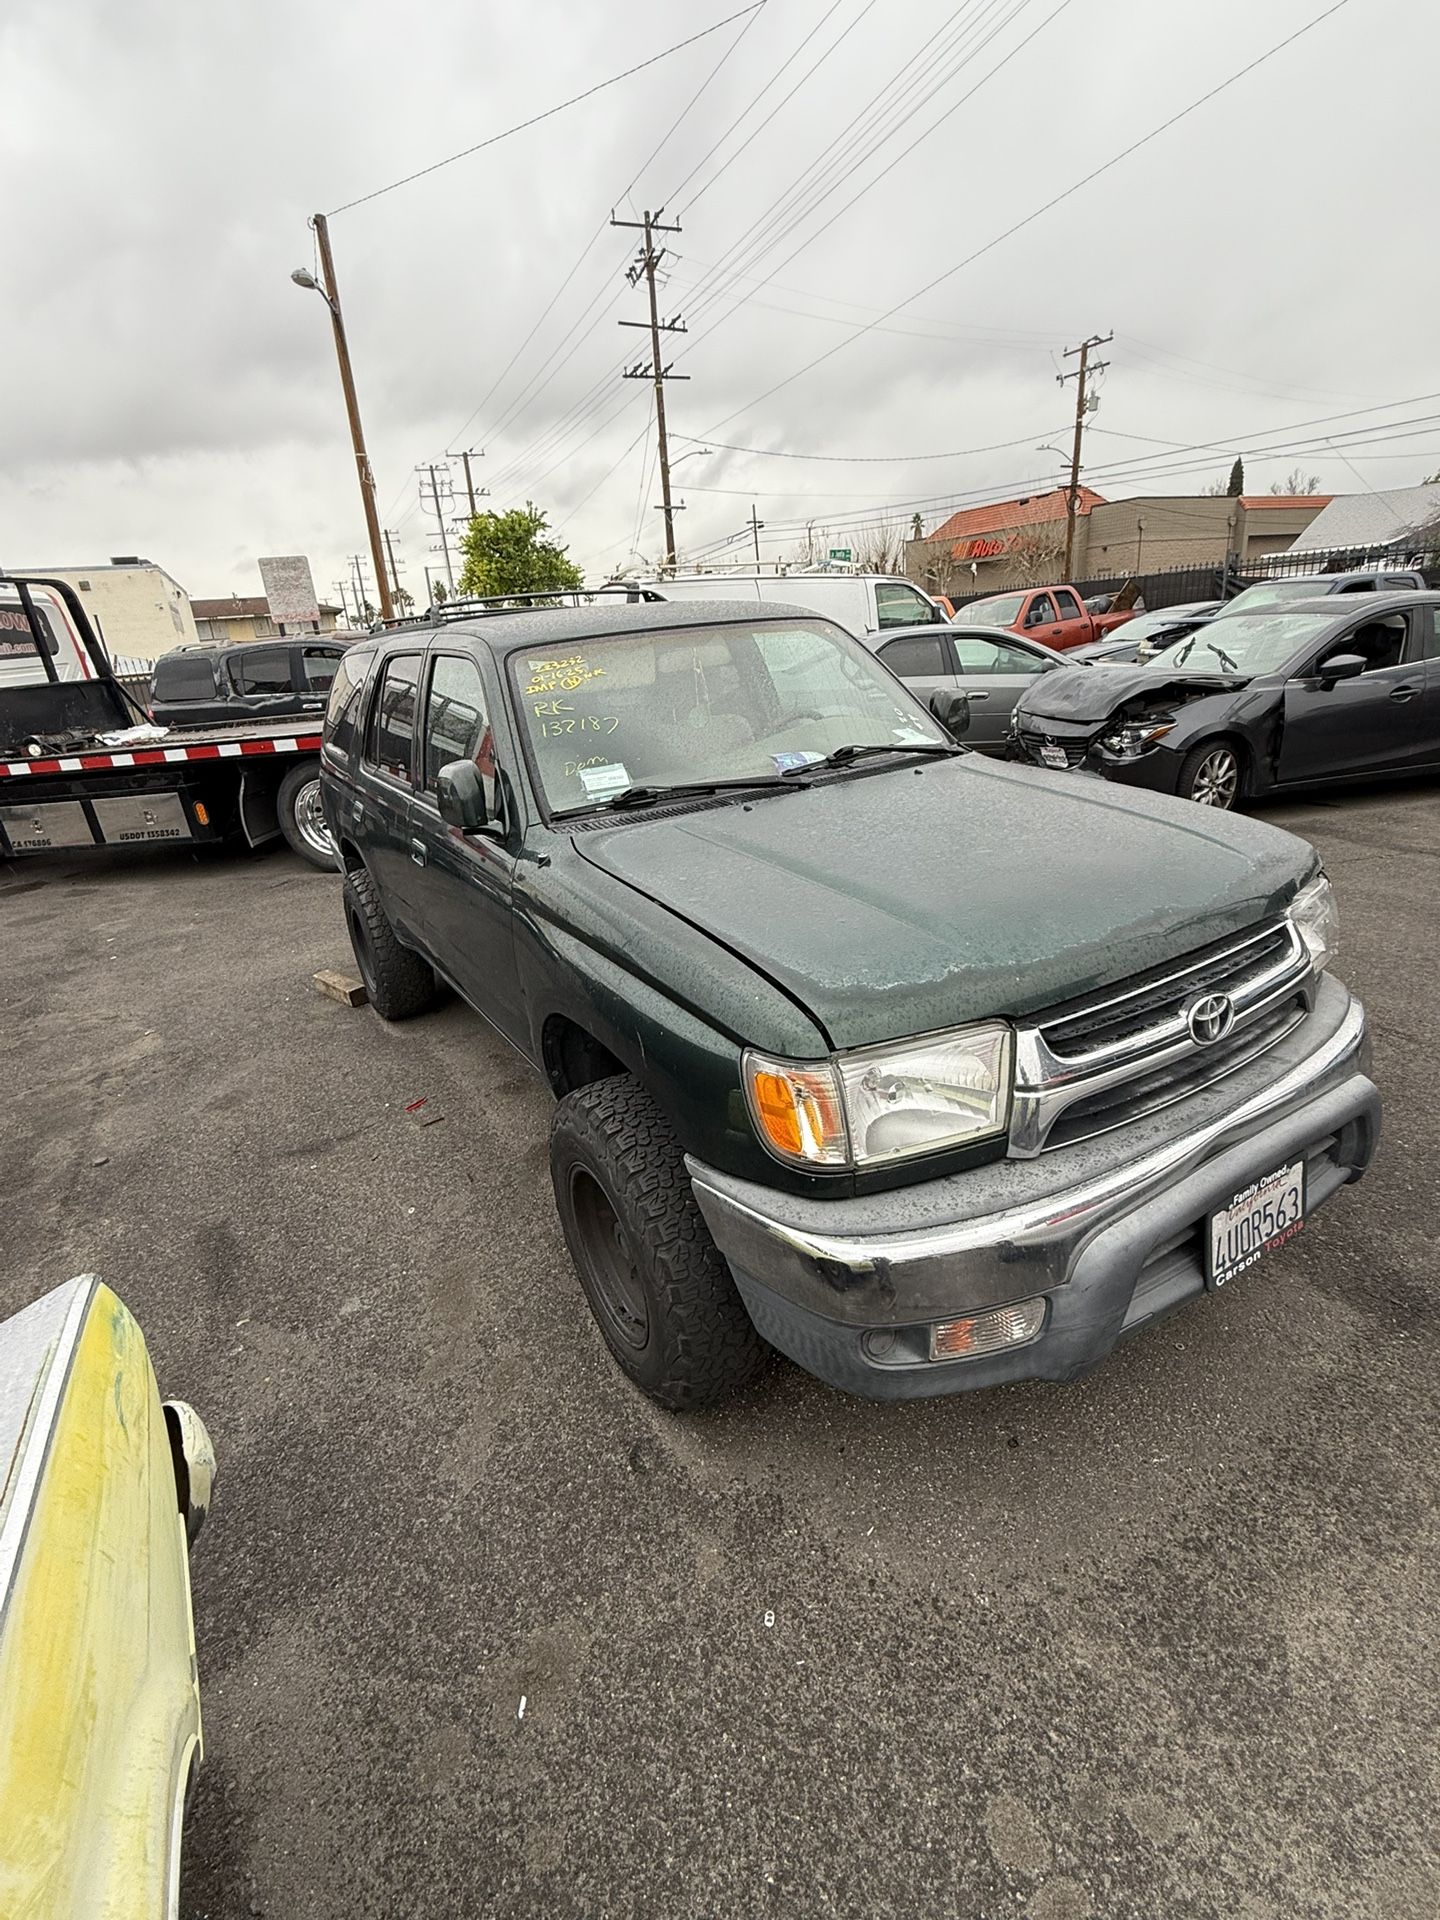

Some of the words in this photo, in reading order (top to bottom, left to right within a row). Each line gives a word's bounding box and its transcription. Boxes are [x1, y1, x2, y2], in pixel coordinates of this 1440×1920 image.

[533, 699, 575, 718] RK
[11, 840, 23, 849] CA
[119, 831, 145, 841] USDOT
[1233, 1183, 1259, 1206] Family
[1215, 1251, 1261, 1287] Carson
[1264, 1220, 1304, 1252] Toyota
